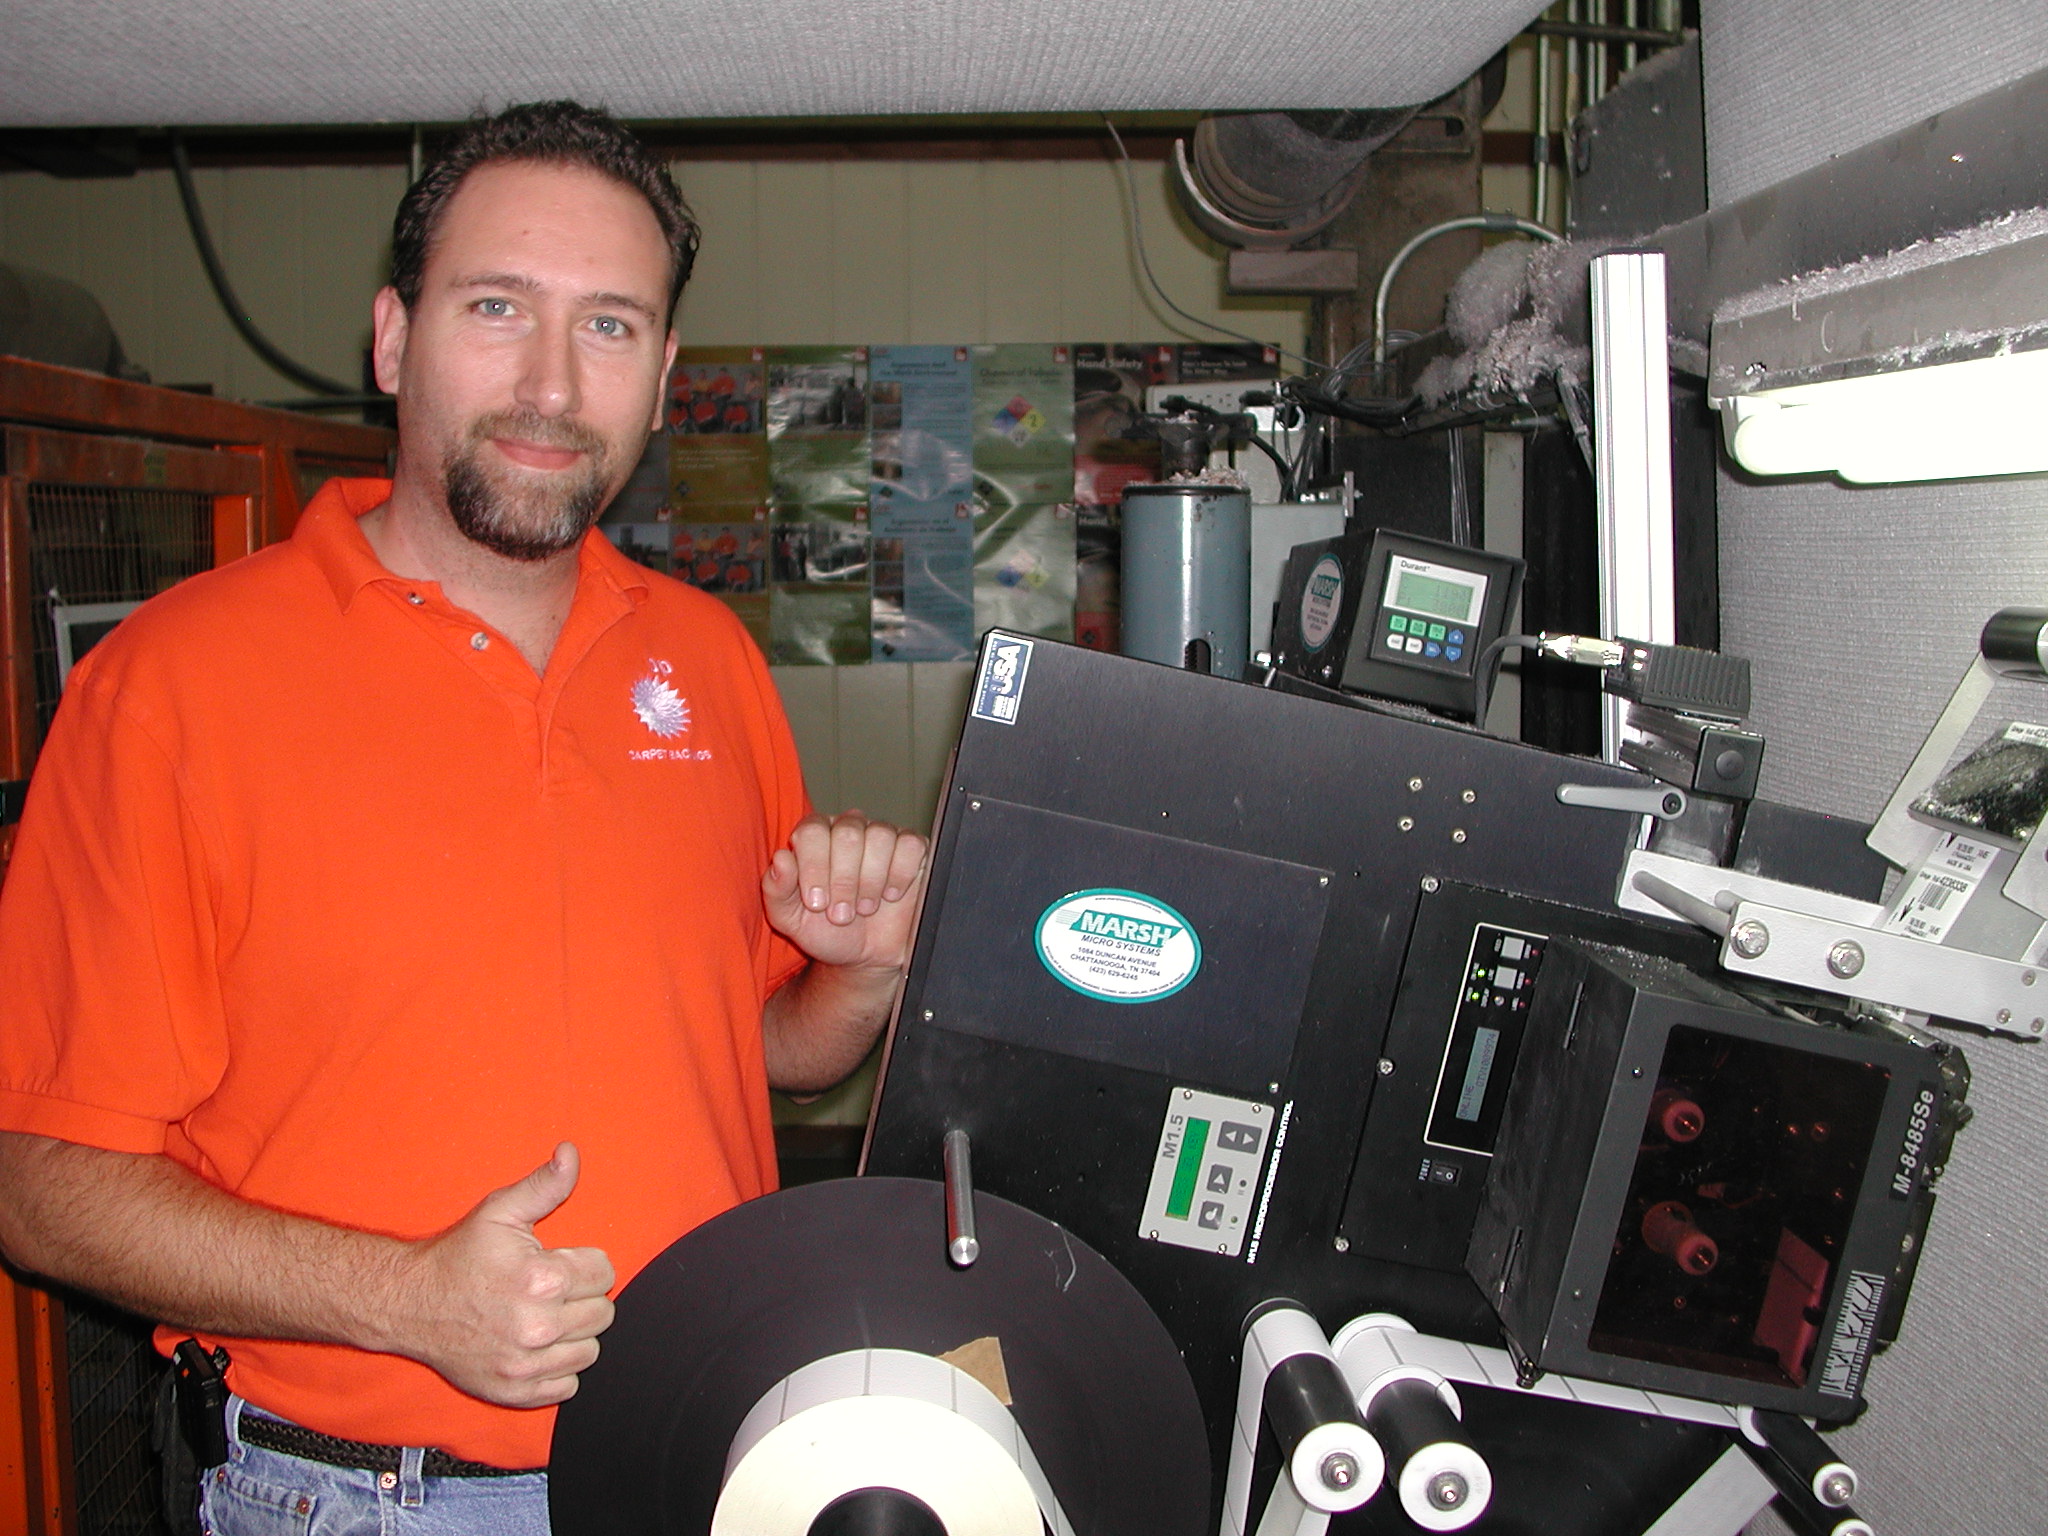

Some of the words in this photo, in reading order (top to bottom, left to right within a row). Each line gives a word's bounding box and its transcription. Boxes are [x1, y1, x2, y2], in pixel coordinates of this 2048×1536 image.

[1077, 358, 1106, 369] Hand
[1108, 357, 1143, 370] Safety
[1401, 560, 1427, 572] Durant
[990, 645, 1021, 695] USA
[1080, 911, 1173, 946] MARSH
[1081, 934, 1114, 947] MICRO
[1115, 941, 1162, 957] SYSTEMS
[1095, 950, 1126, 962] DUNCAN
[1127, 957, 1157, 968] AVENUE
[1070, 953, 1127, 971] CHATTANOOGA,
[1129, 965, 1139, 973] TN
[1458, 1085, 1475, 1118] ONLINE
[1162, 1114, 1183, 1159] M1.5
[1892, 1089, 1935, 1195] M-8485Se
[1252, 1148, 1282, 1240] MICROPROCESSOR
[1275, 1099, 1294, 1148] CONTROL
